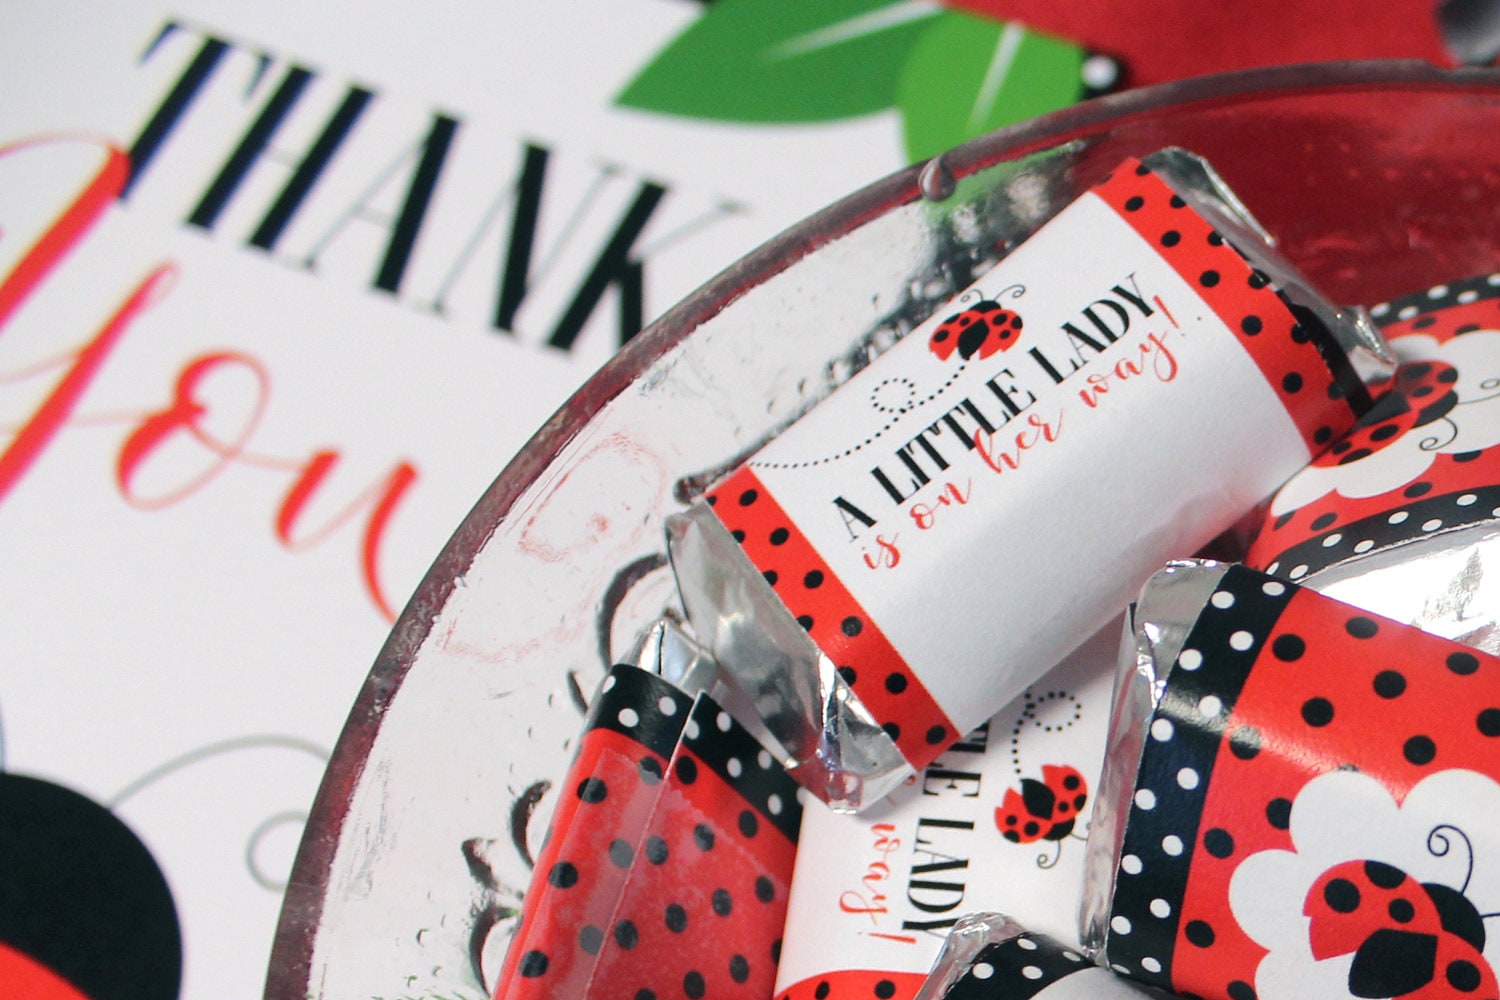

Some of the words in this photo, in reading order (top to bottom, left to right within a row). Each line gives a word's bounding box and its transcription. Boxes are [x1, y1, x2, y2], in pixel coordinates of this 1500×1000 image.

[118, 20, 750, 366] THANK
[832, 495, 877, 543] A
[870, 368, 1037, 505] LITTLE
[1027, 272, 1155, 386] LADY
[860, 531, 903, 572] is
[908, 478, 973, 531] on
[972, 408, 1065, 476] her
[1076, 294, 1190, 409] way!
[838, 822, 917, 944] way!
[902, 816, 976, 940] LADY
